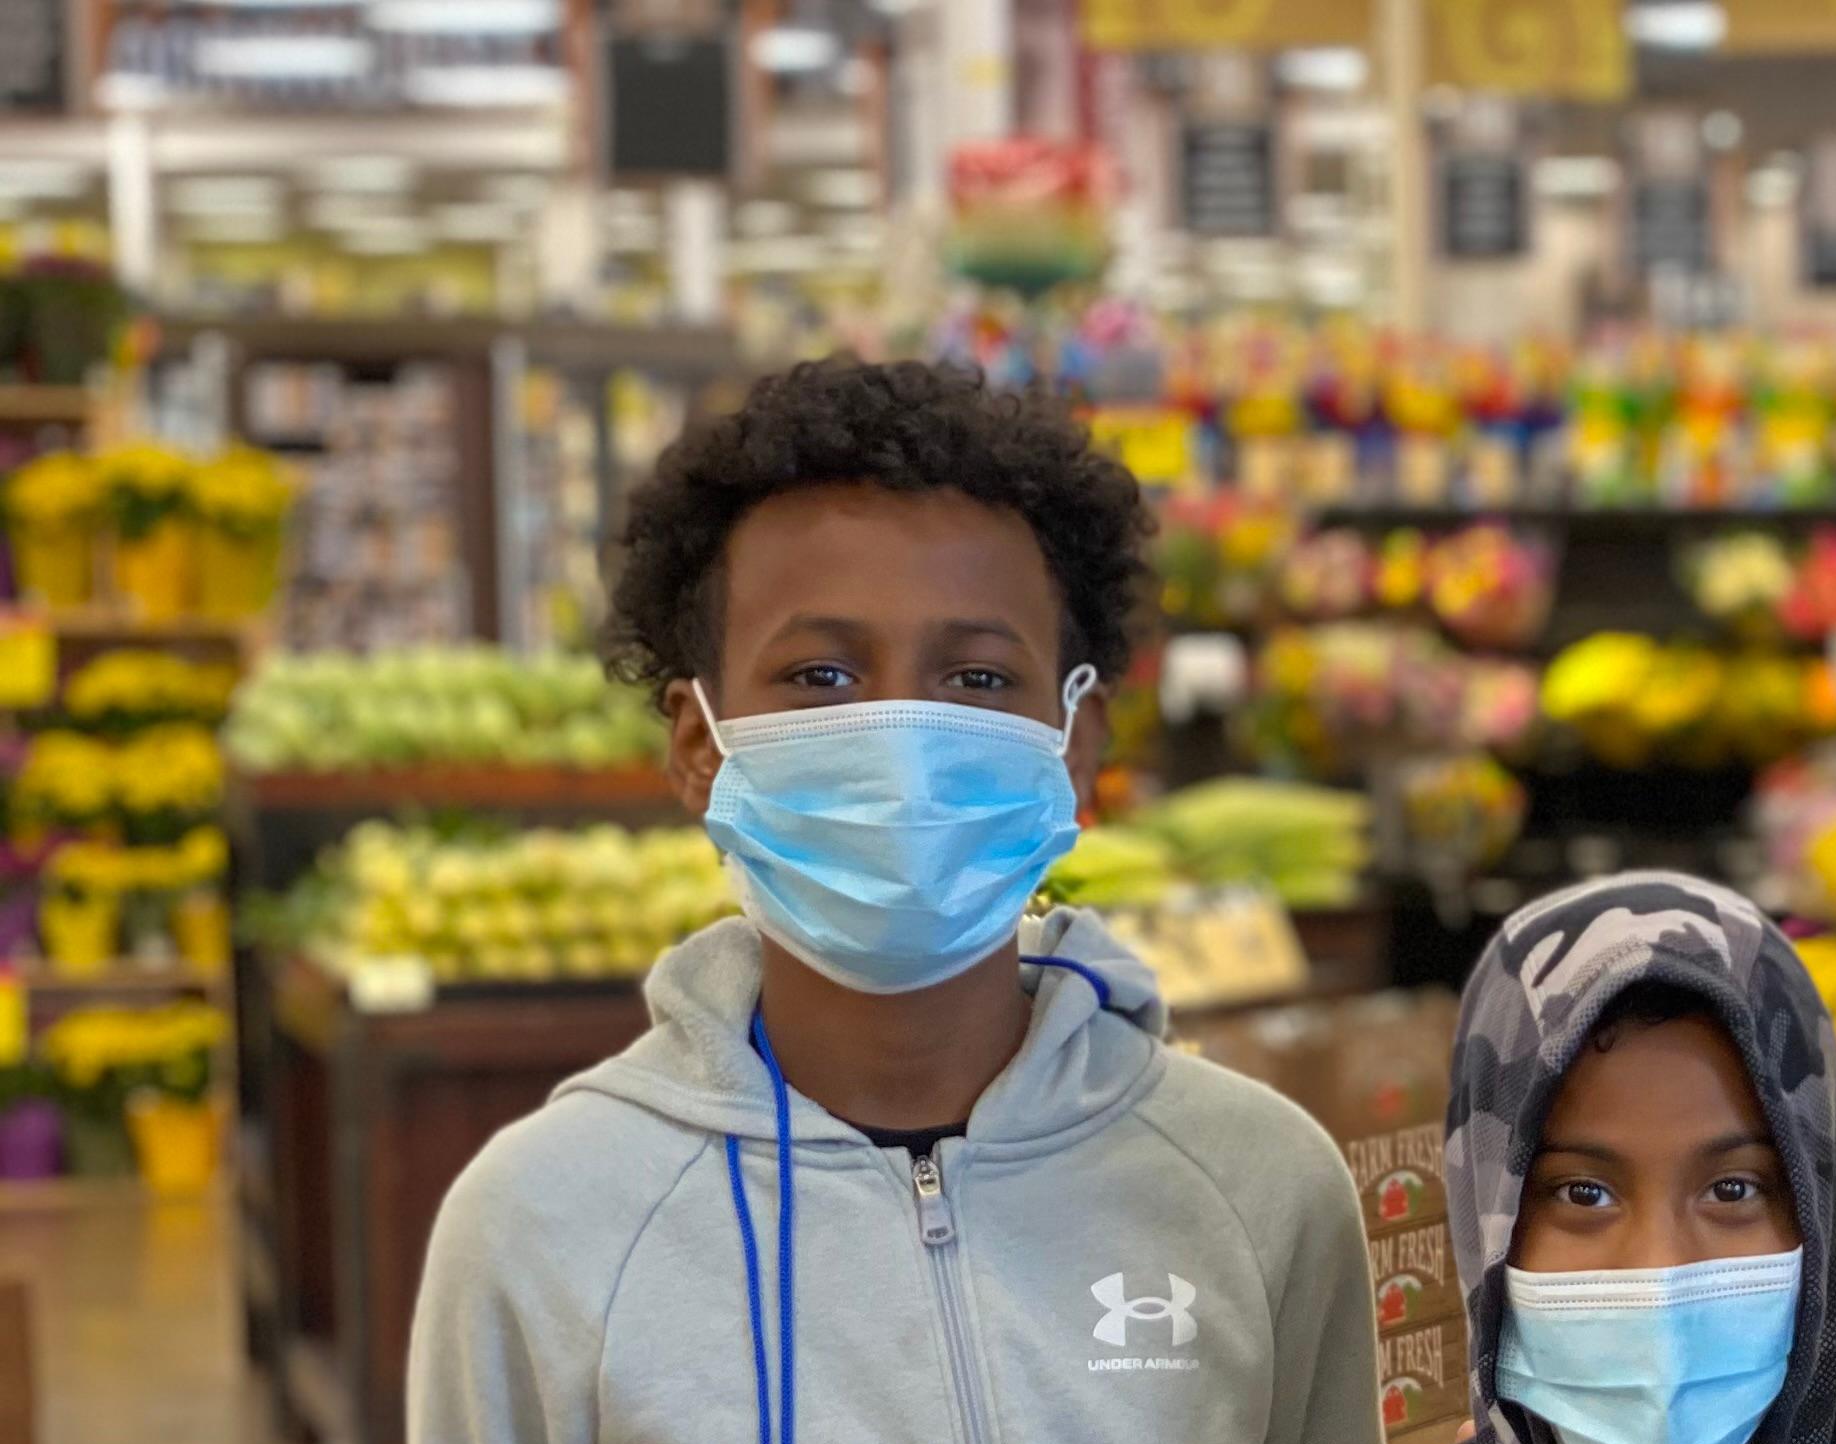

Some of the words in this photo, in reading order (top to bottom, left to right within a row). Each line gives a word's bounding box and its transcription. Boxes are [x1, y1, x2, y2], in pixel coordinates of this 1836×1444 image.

[1397, 1122, 1445, 1185] FRESH
[1398, 1223, 1445, 1288] FRESH
[1087, 1358, 1142, 1371] UNDER
[1396, 1324, 1444, 1389] FRESH
